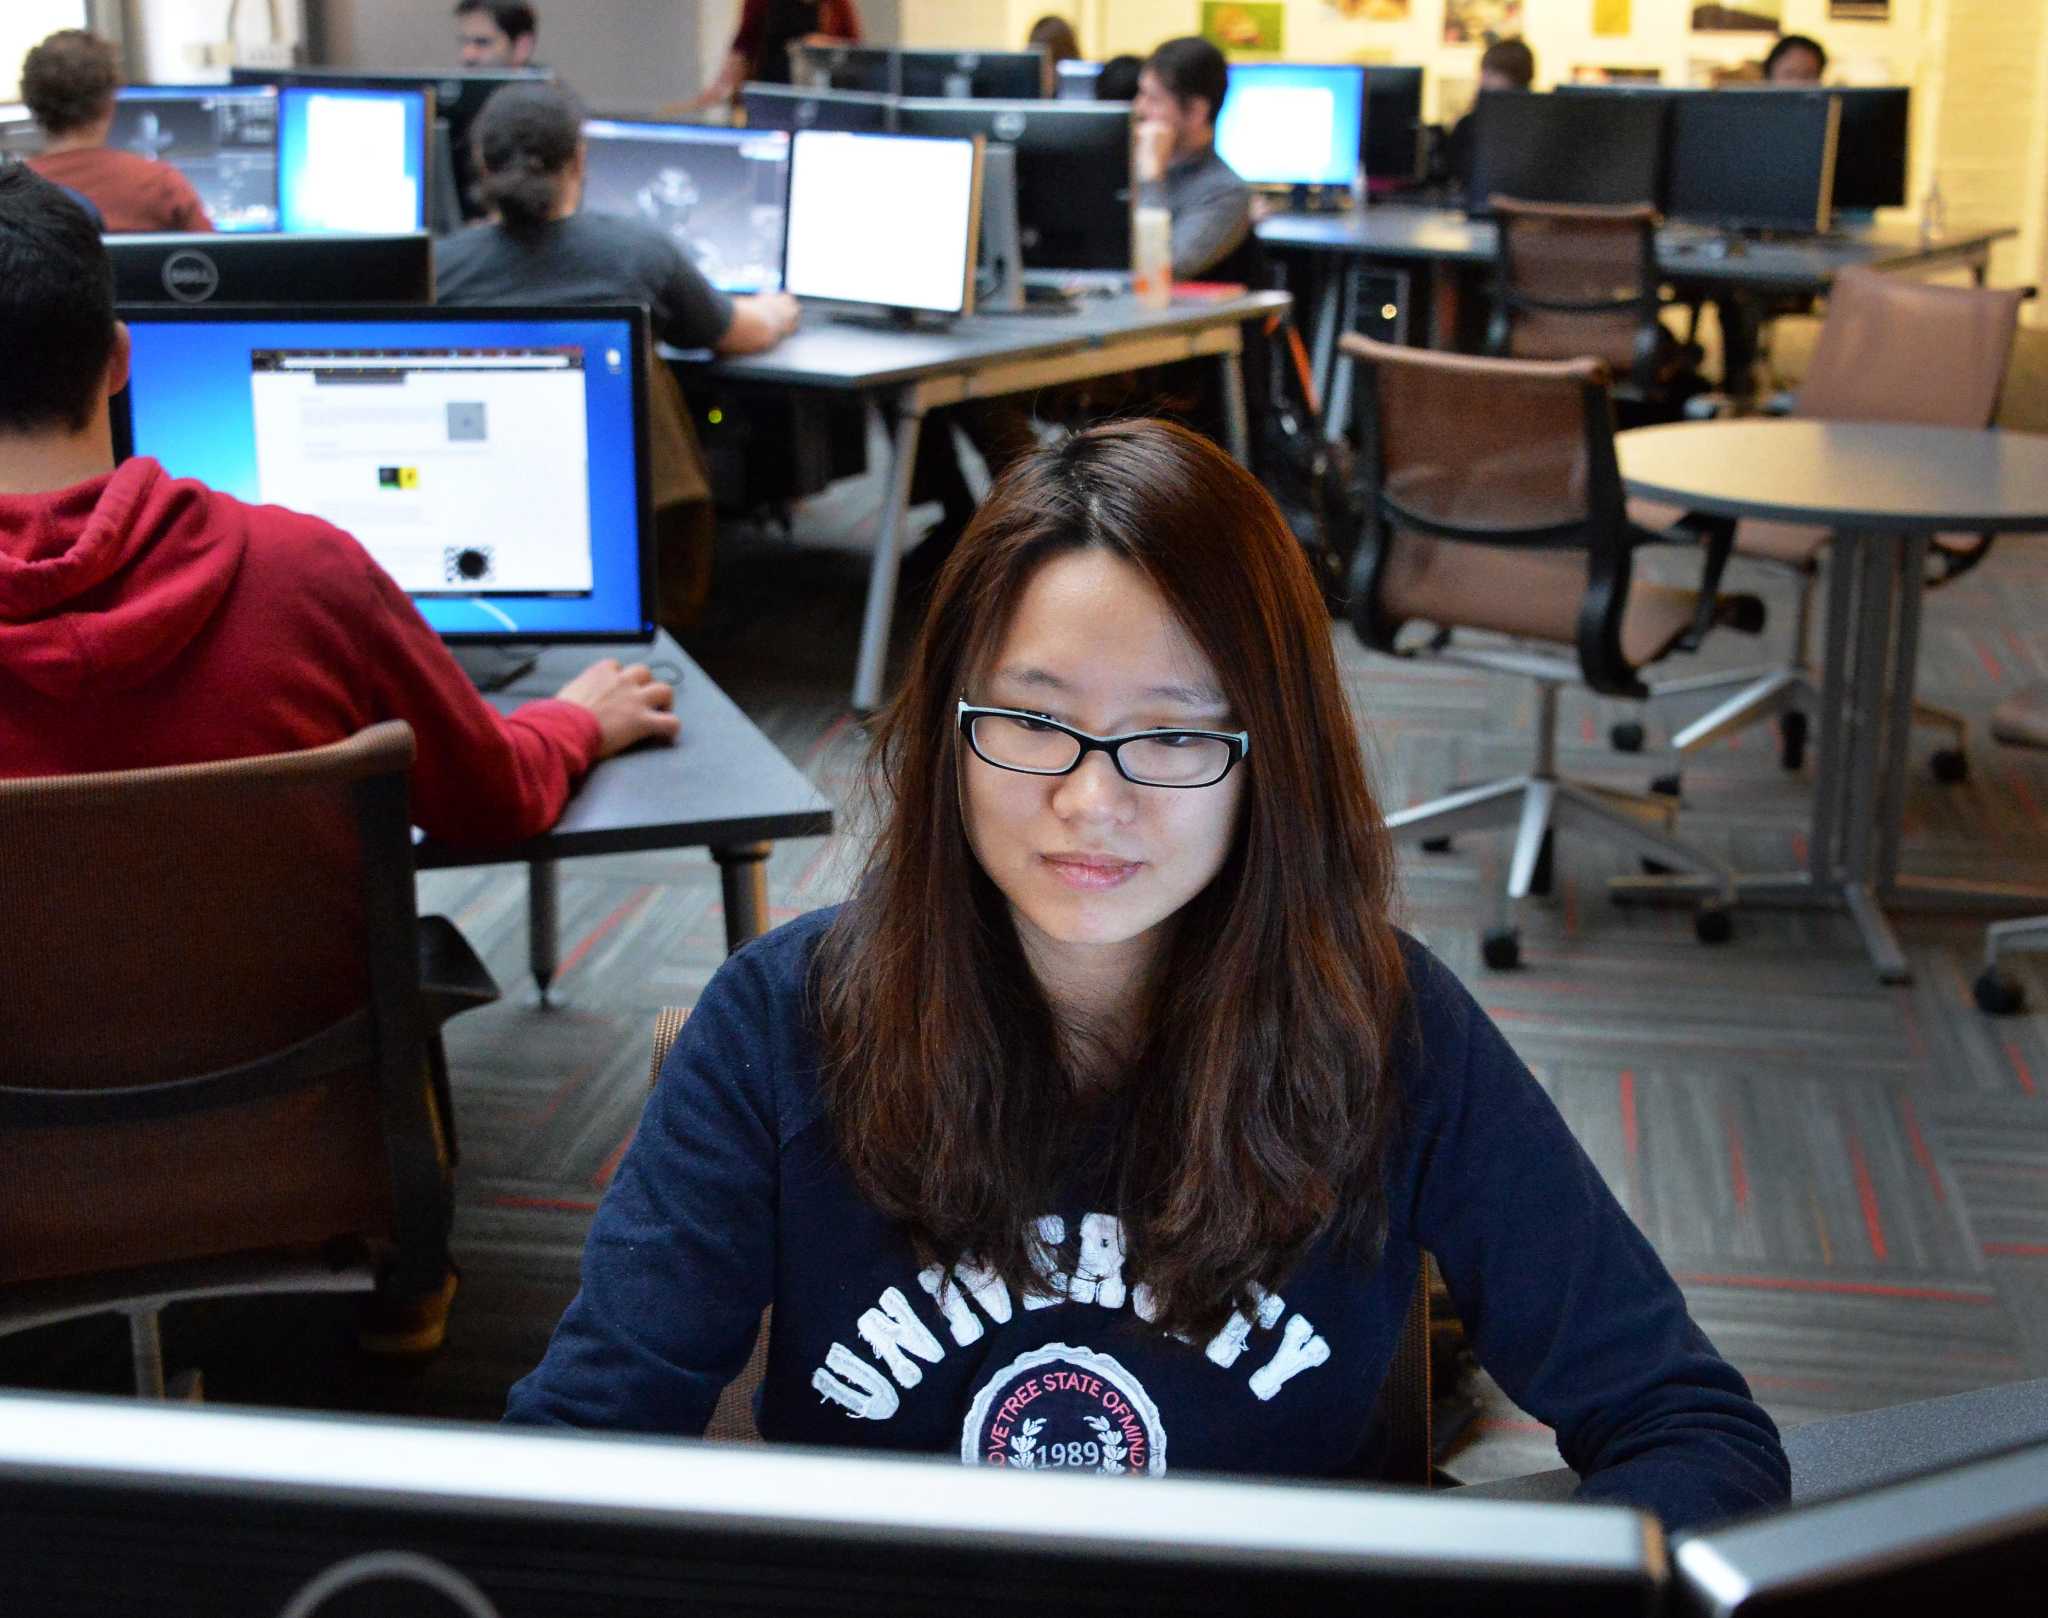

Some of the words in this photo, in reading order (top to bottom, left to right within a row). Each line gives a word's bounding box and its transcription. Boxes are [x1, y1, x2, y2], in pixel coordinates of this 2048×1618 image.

[811, 1213, 1331, 1420] UNIVERTY
[997, 1380, 1042, 1422] TREE
[1043, 1372, 1102, 1397] STATE
[1103, 1391, 1130, 1415] OF
[988, 1424, 1009, 1471] OVE
[1036, 1442, 1099, 1467] 1989
[1118, 1414, 1145, 1466] MIND
